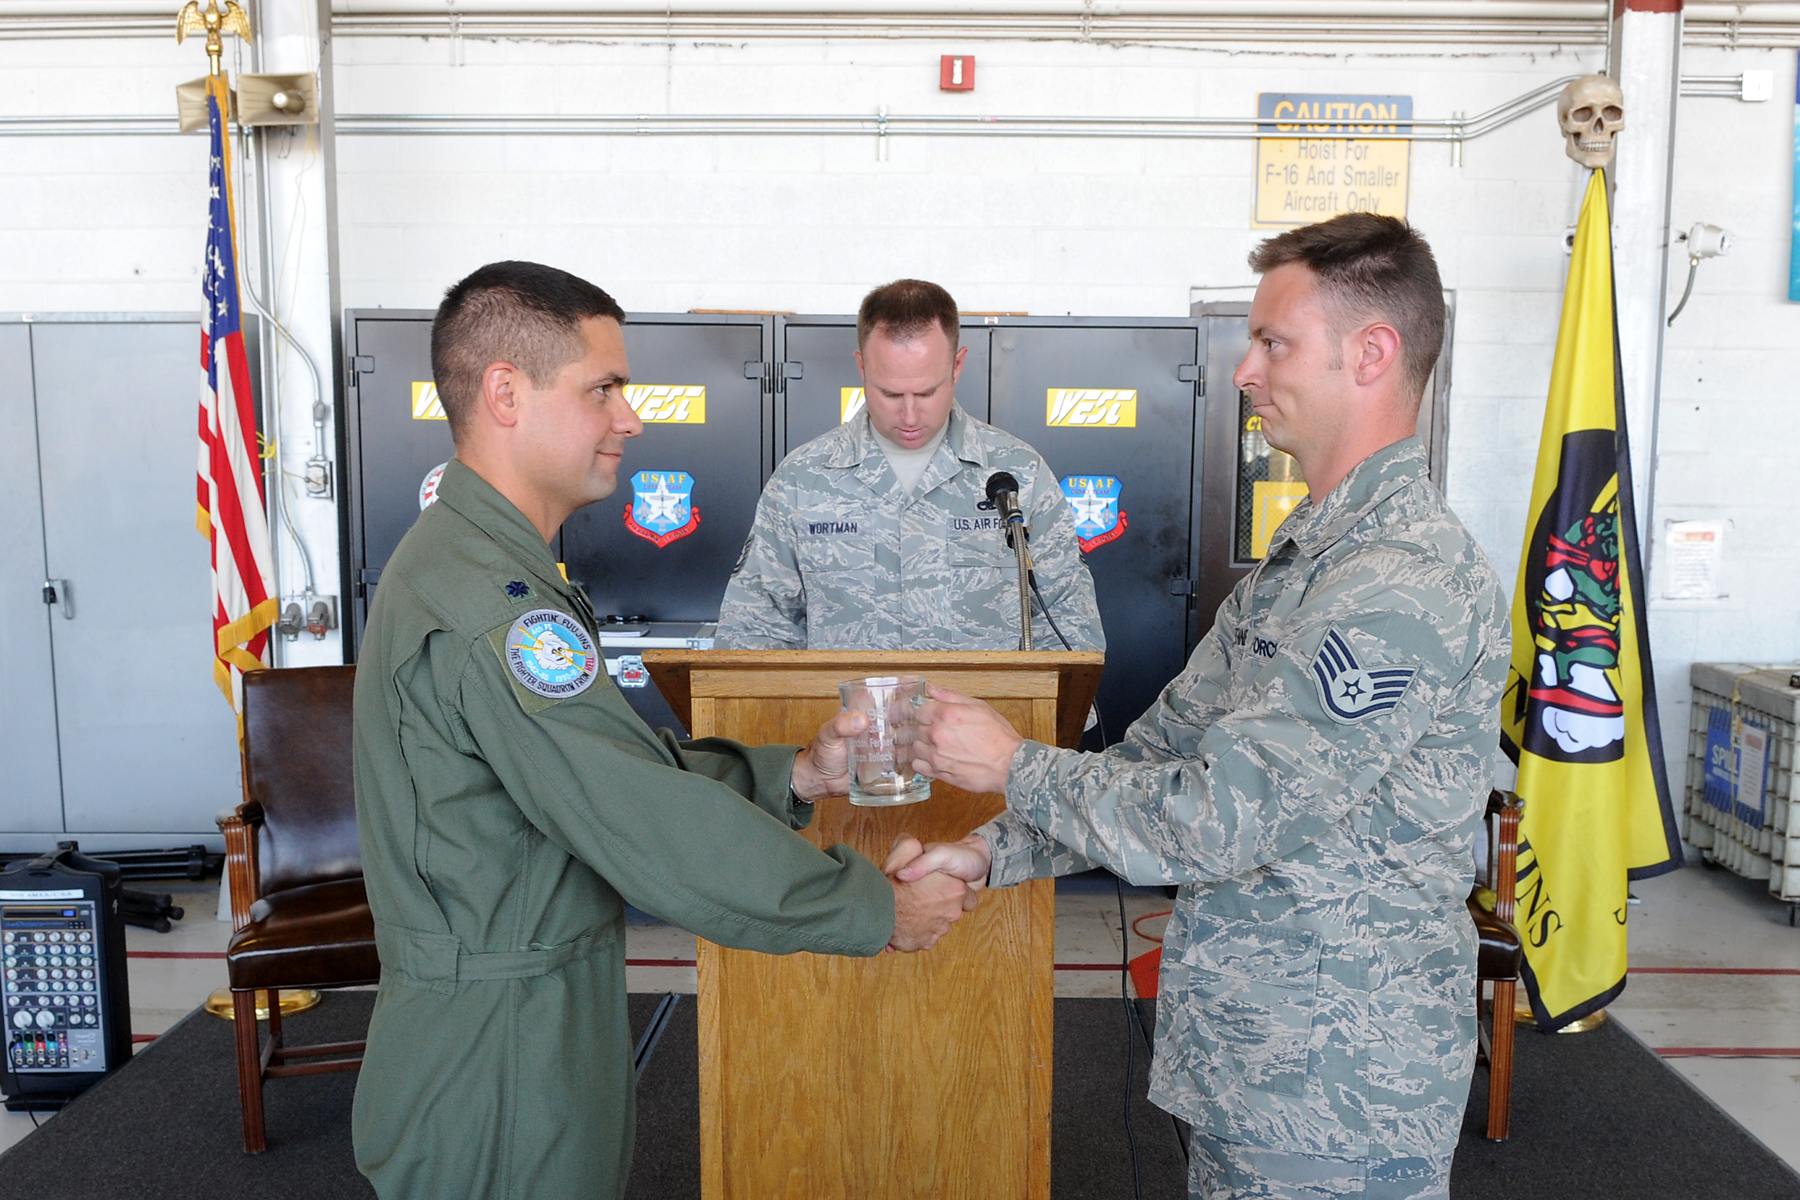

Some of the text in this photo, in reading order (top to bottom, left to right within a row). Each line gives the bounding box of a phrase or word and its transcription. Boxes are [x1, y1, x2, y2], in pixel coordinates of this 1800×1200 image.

[1274, 101, 1398, 134] CAUTION
[1298, 138, 1369, 160] Hoist For
[1265, 163, 1400, 187] F-16 And Smaller
[1283, 190, 1380, 214] Aircraft Only
[808, 522, 858, 535] WORTMAN
[953, 519, 972, 531] U.S.
[974, 517, 991, 530] AIR
[510, 648, 520, 661] THE
[514, 661, 538, 687] FIGHTER
[536, 681, 576, 694] SQUADRON
